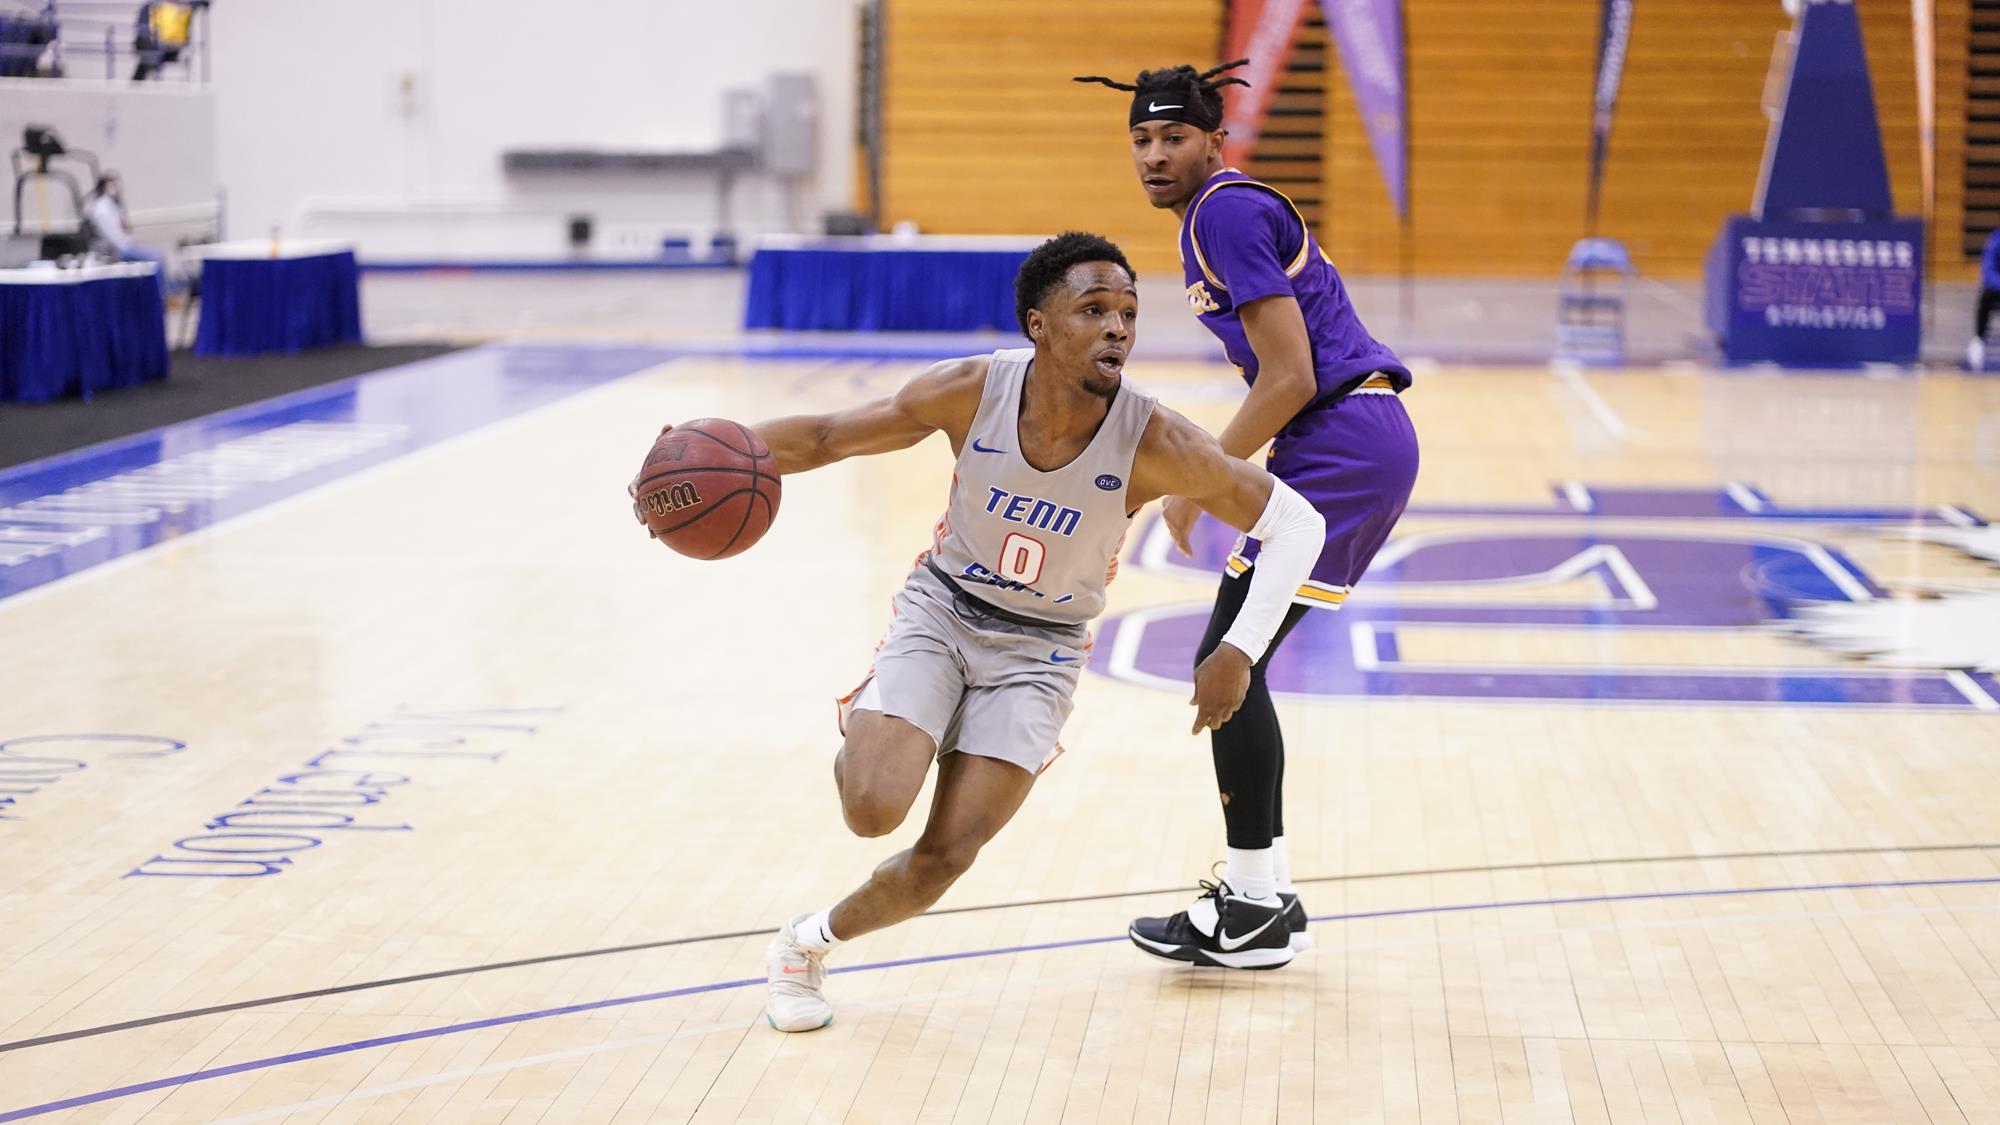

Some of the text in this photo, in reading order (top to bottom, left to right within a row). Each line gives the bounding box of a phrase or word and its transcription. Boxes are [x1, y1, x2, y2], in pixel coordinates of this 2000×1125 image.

[1742, 236, 1914, 268] TENNESSEE
[1737, 264, 1916, 312] STATE
[640, 480, 703, 517] Wilso
[984, 485, 1083, 537] TENN
[998, 532, 1046, 586] 0
